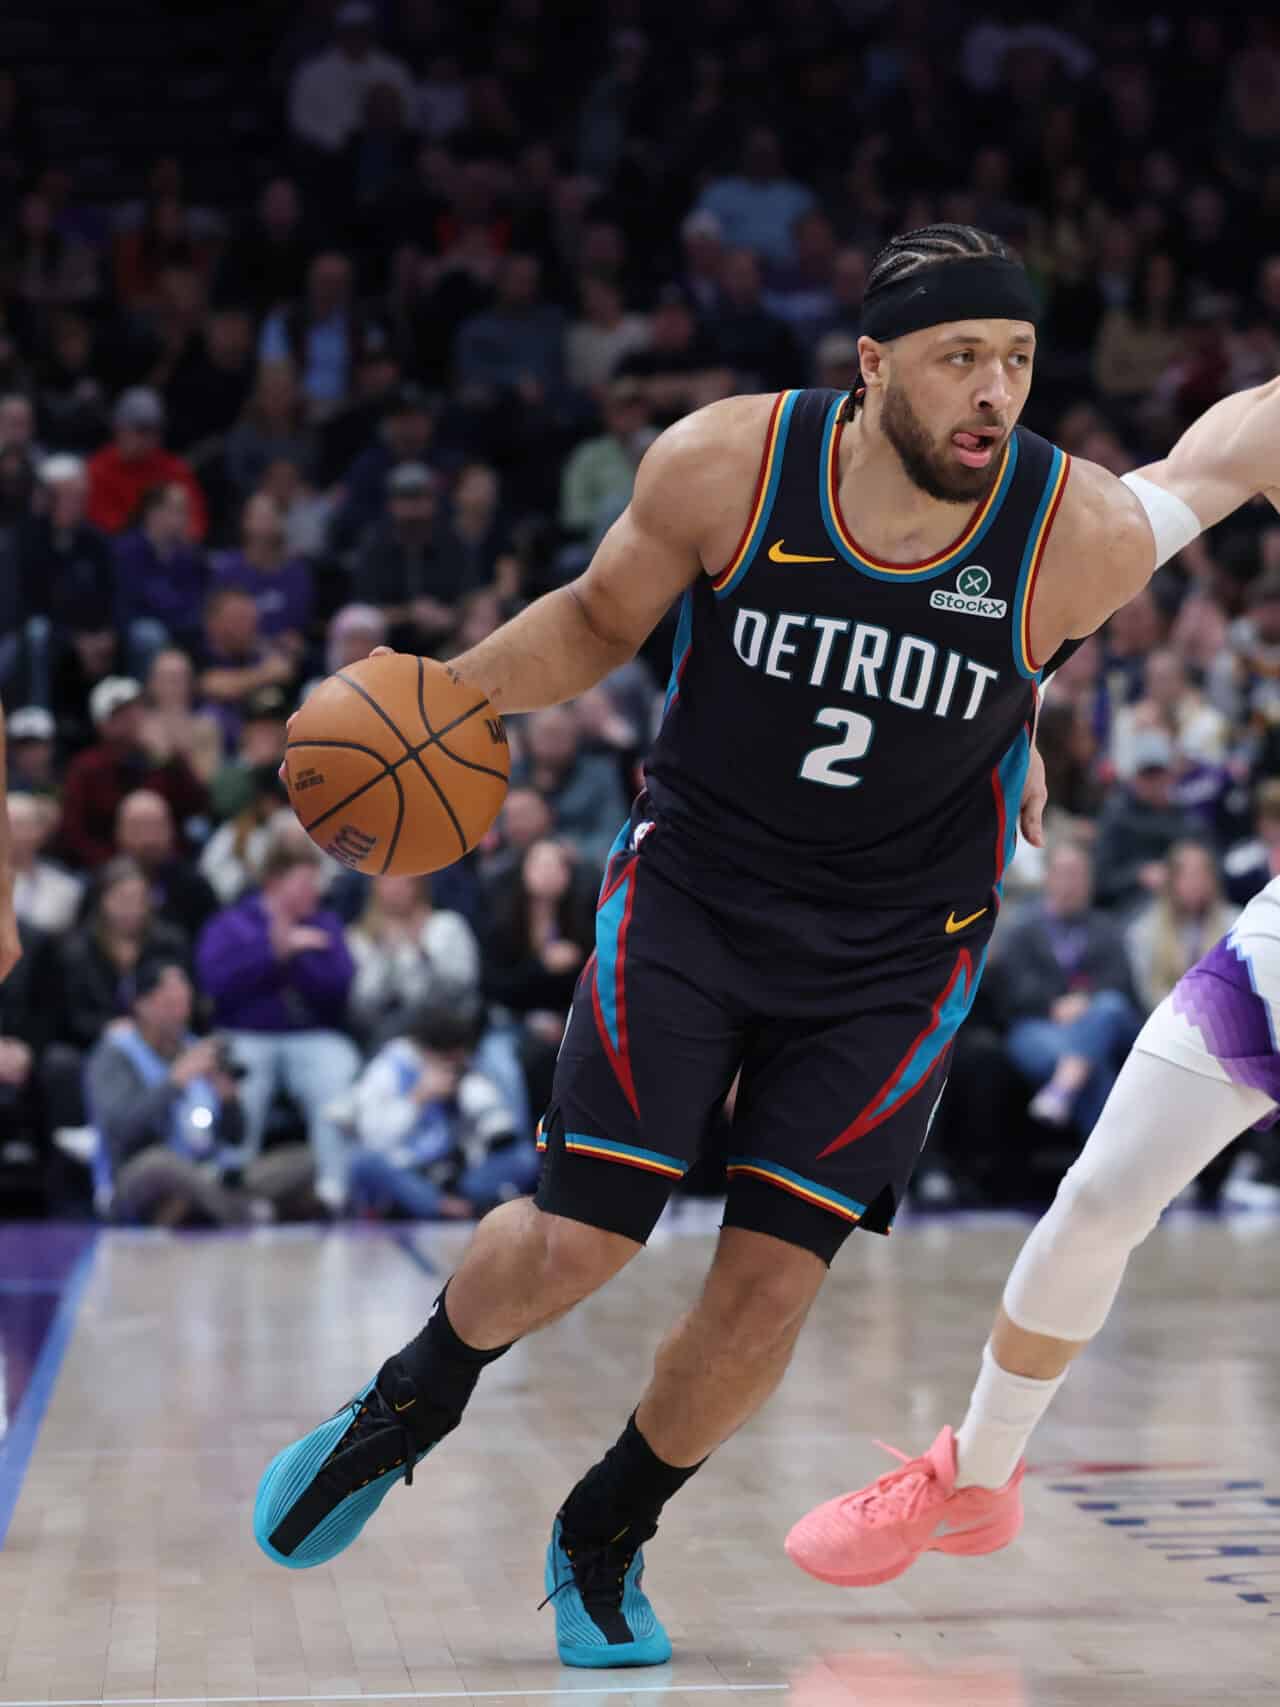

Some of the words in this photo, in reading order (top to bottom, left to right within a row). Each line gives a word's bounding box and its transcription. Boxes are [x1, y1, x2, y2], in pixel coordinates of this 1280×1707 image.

[933, 592, 1005, 617] StockX
[732, 607, 999, 720] DETROIT
[800, 707, 872, 787] 2
